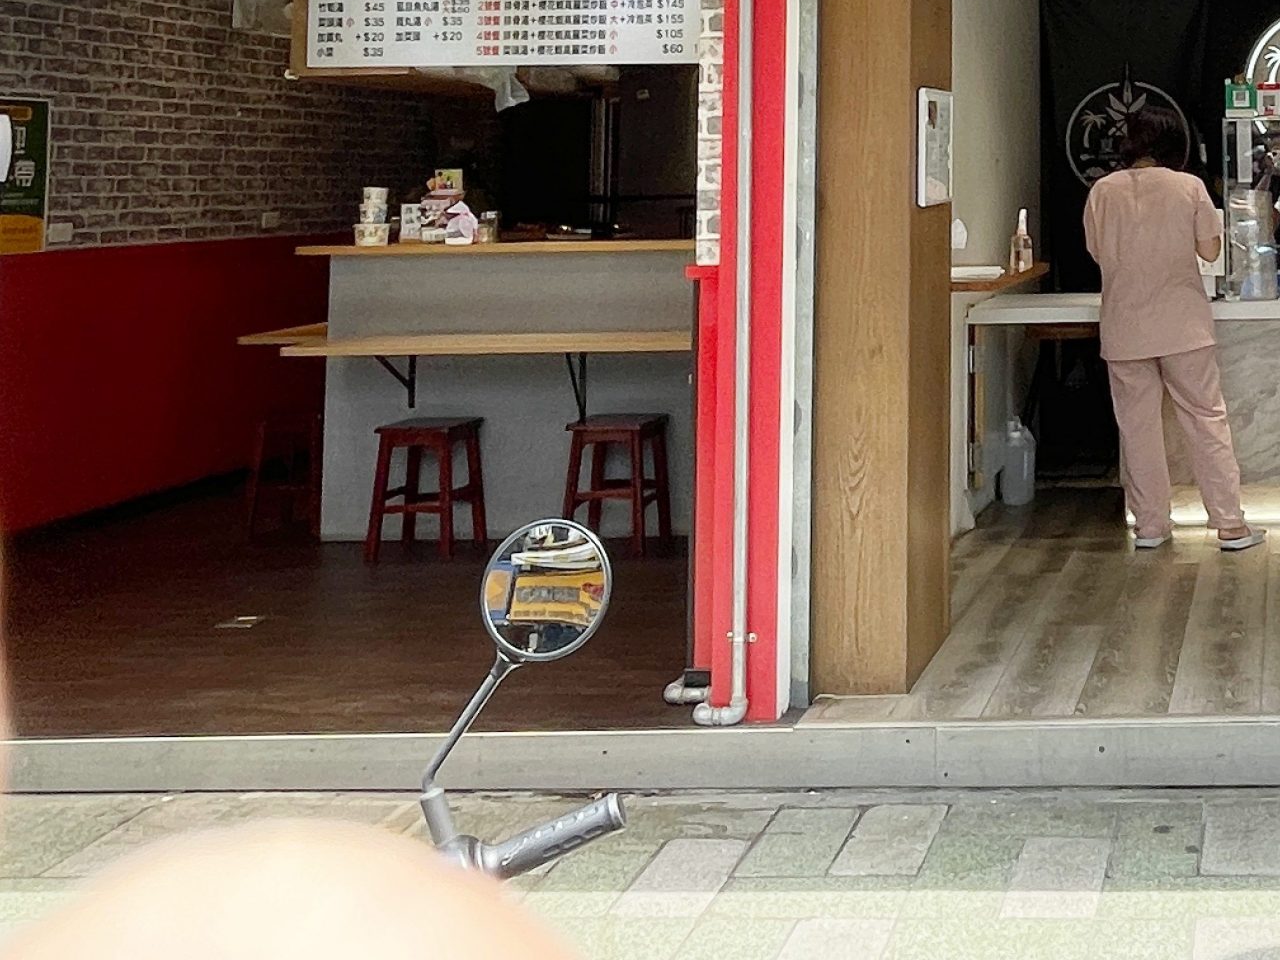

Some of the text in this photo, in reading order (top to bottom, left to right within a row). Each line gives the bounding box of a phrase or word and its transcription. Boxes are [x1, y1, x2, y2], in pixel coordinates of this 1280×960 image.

[364, 3, 385, 12] $45
[657, 0, 685, 9] $145
[364, 17, 385, 27] $35
[442, 17, 463, 26] $35
[657, 14, 685, 24] $155
[656, 29, 684, 39] $105
[363, 47, 384, 57] $35
[663, 43, 684, 54] $60
